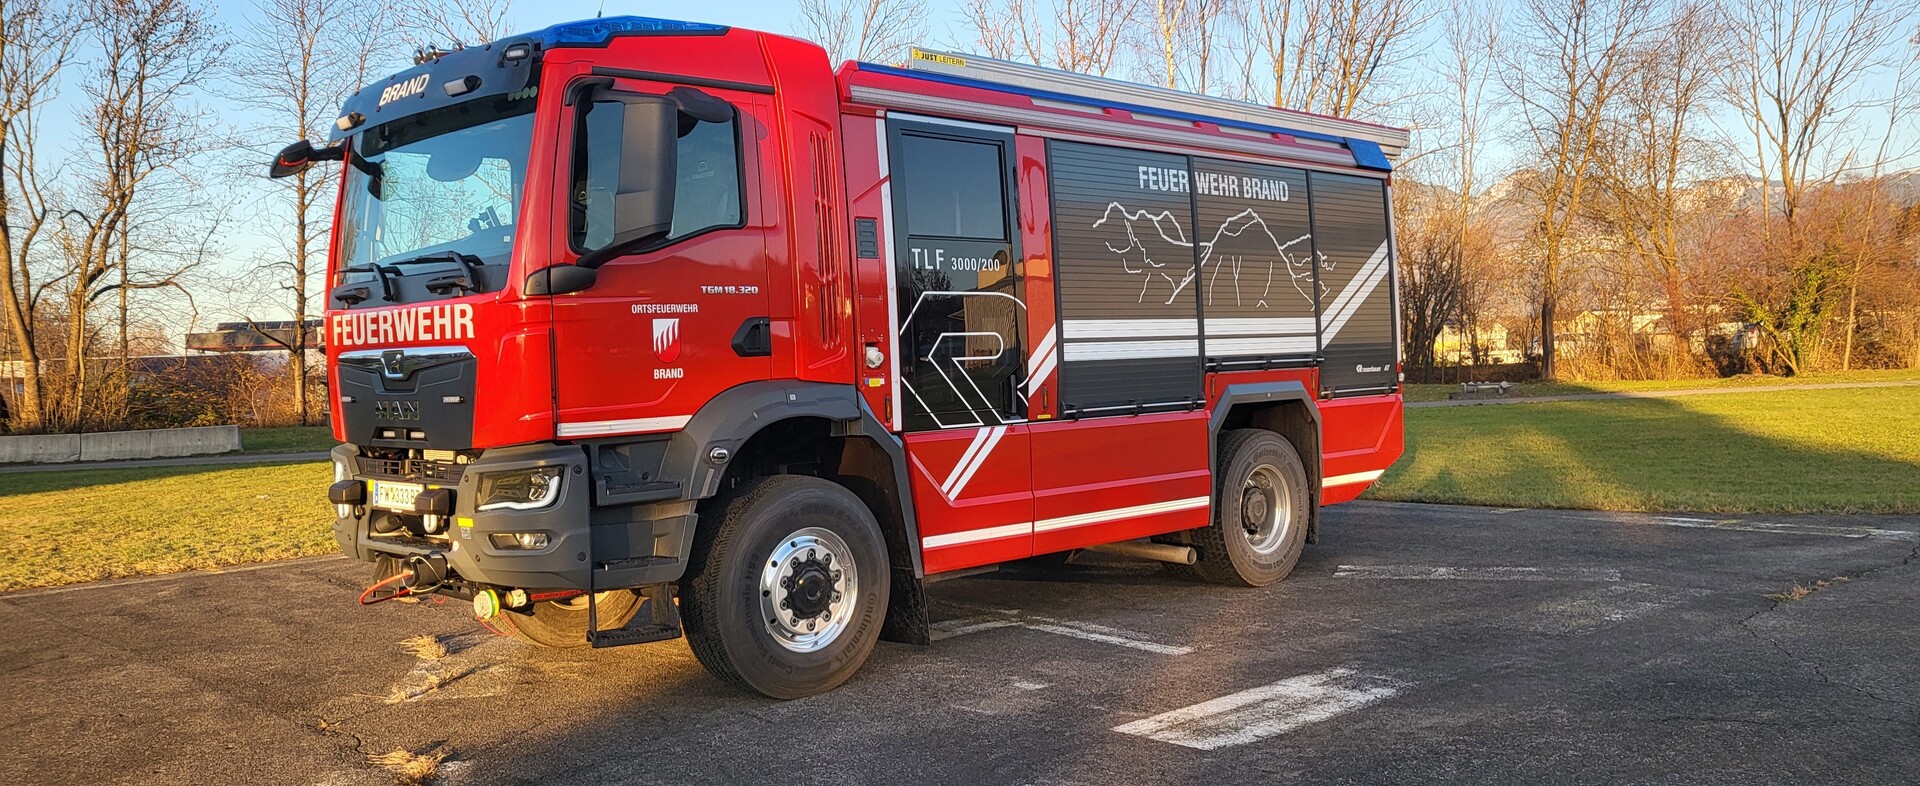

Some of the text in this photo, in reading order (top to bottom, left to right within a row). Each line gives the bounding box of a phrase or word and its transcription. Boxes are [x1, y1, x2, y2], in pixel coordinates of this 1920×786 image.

[921, 53, 965, 66] JUST LEITERN
[379, 73, 430, 106] BRAND
[1242, 177, 1289, 202] BRAND
[911, 248, 1000, 272] TLF 3000/200
[701, 285, 759, 294] TGM 18.320
[631, 303, 699, 314] ORTSFEUERWEHR
[332, 303, 475, 347] FEUERWEHR
[653, 368, 684, 379] BRAND
[374, 400, 420, 421] MAN
[395, 487, 420, 505] 333B
[842, 591, 878, 661] Continental
